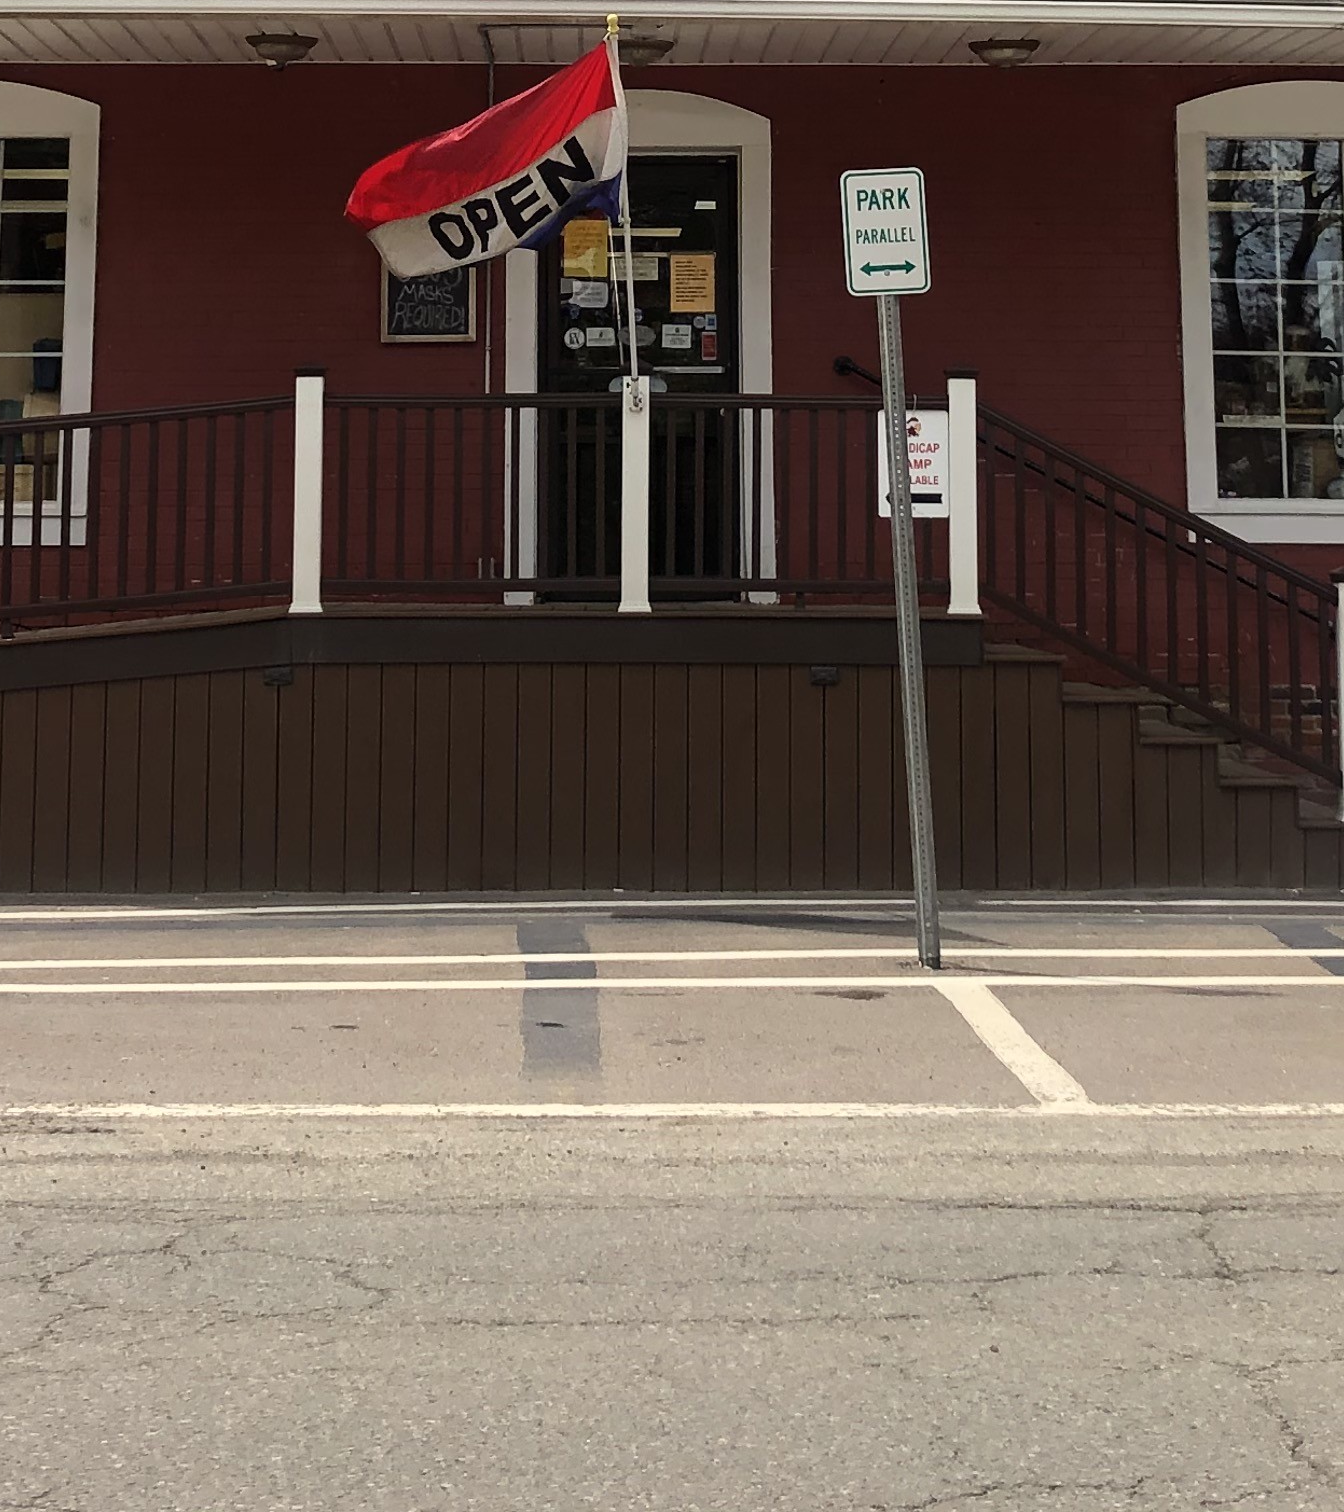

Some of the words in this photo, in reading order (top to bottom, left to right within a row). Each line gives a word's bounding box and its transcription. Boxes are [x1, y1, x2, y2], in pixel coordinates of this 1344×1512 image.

[428, 136, 596, 261] OPEN
[856, 187, 911, 212] PARK
[855, 226, 916, 245] PARALLEL
[397, 283, 454, 305] MASKS
[908, 442, 940, 454] DICAP
[907, 459, 932, 470] AMP
[909, 475, 939, 485] LABLE
